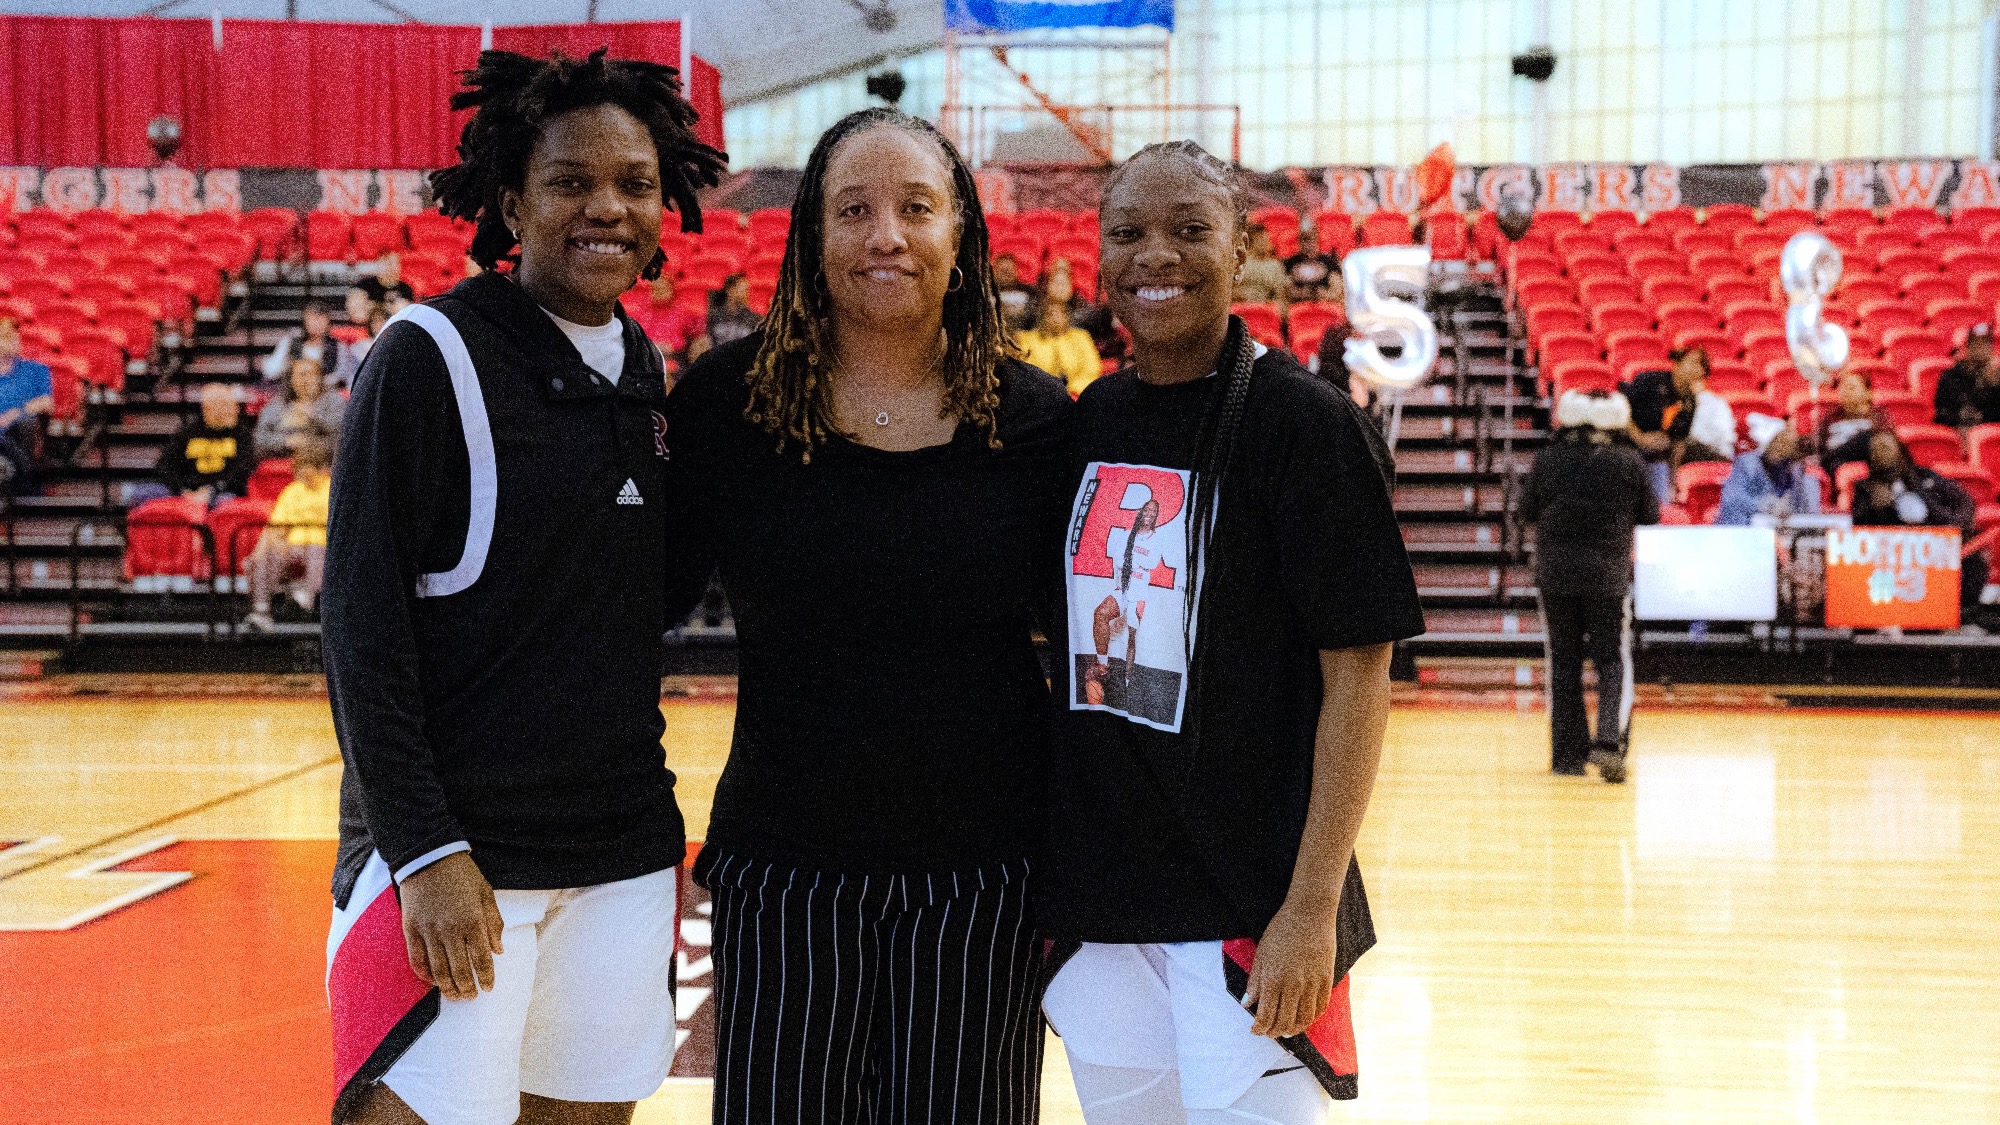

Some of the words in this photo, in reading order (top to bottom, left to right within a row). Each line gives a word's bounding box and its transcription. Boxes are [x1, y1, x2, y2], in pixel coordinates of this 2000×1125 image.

[1343, 245, 1438, 387] 5
[617, 496, 643, 504] adidas
[1071, 480, 1098, 555] NEWARK
[1827, 531, 1962, 569] HORTON
